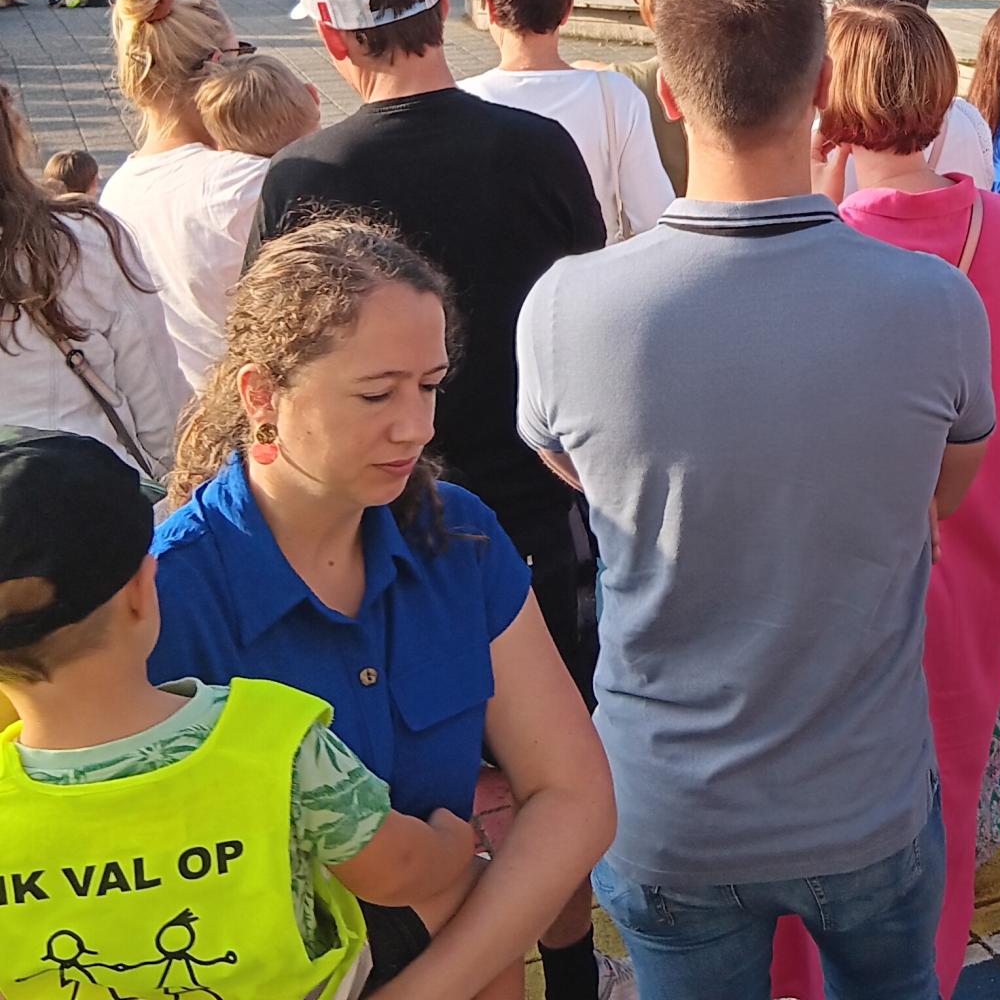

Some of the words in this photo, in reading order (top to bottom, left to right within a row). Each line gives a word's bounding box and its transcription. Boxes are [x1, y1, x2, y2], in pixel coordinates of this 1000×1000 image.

[0, 870, 50, 906] IK
[61, 858, 162, 897] VAL
[178, 840, 244, 880] OP
